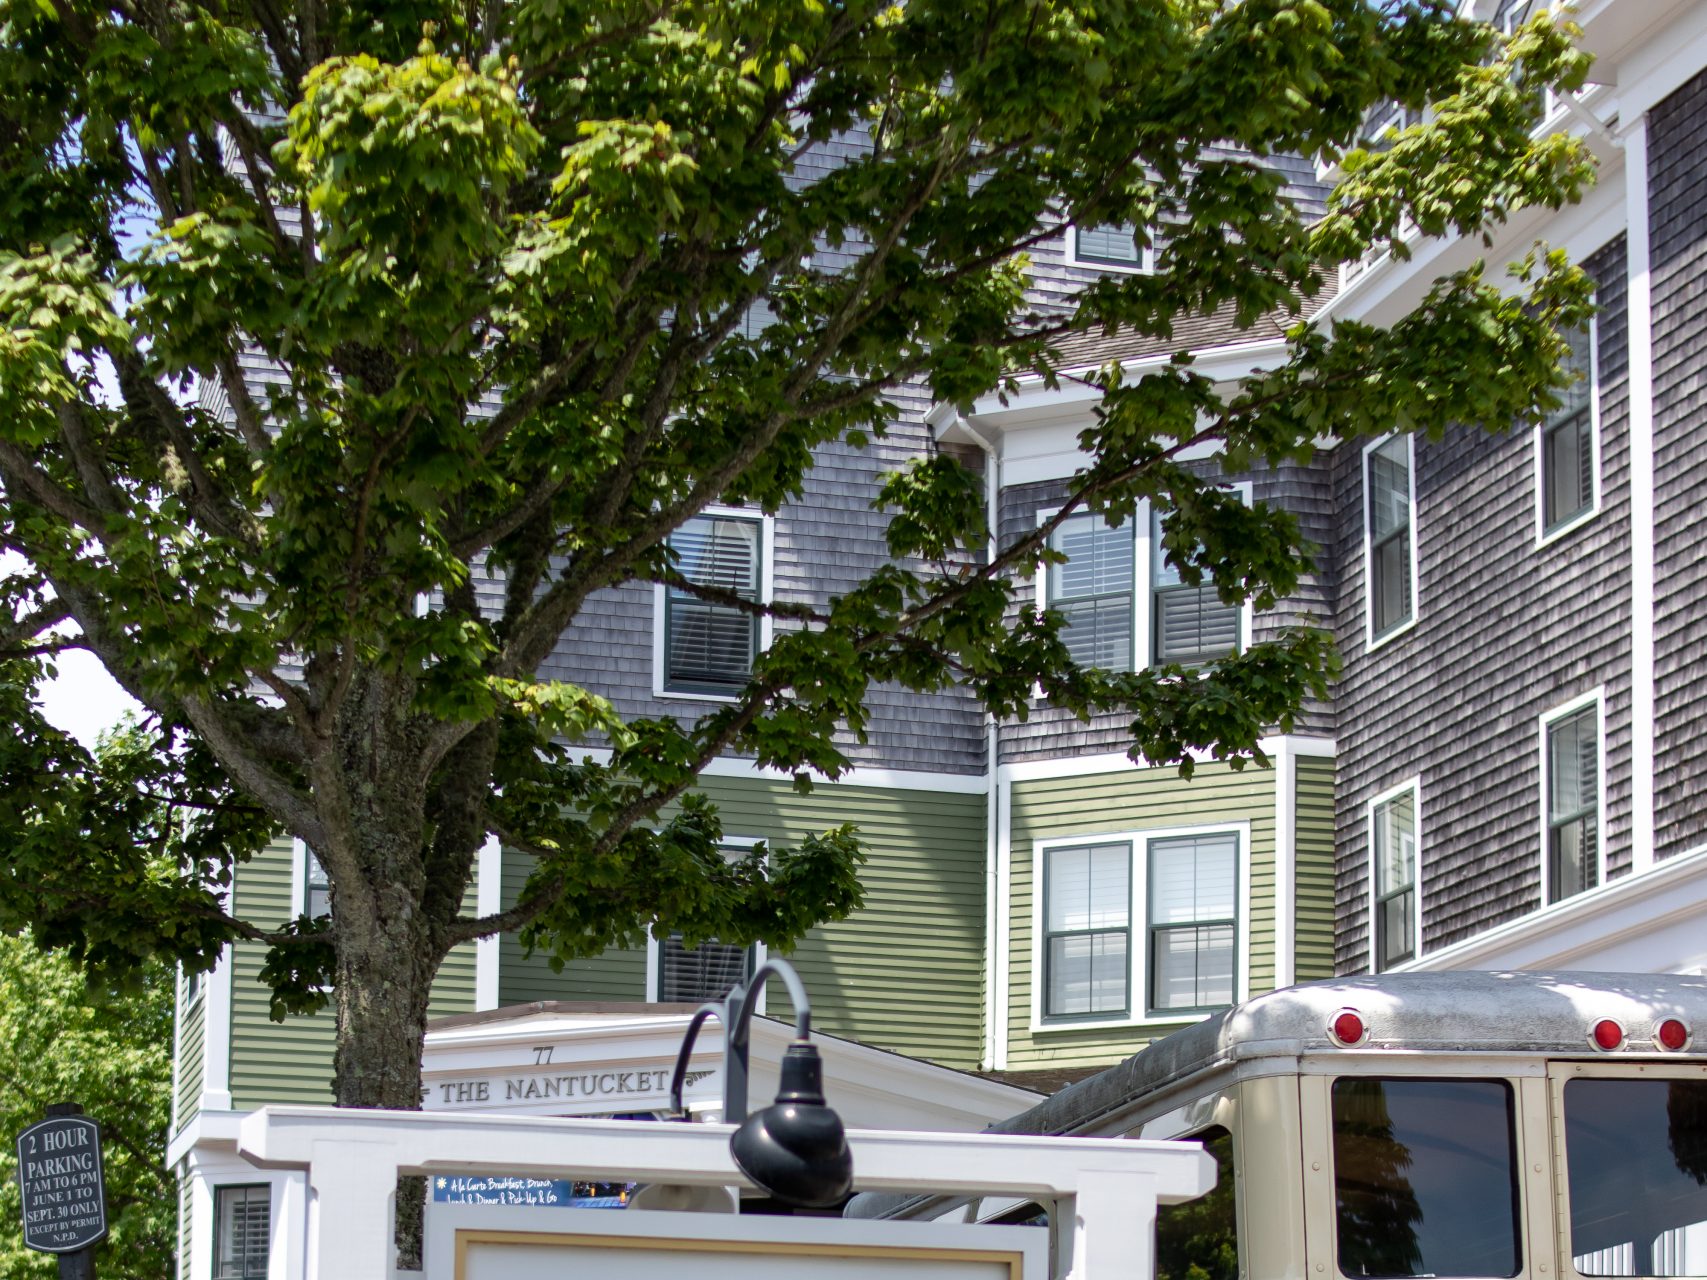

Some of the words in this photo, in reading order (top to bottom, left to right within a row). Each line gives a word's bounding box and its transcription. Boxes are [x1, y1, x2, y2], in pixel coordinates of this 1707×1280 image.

[533, 1046, 554, 1065] 77
[440, 1081, 490, 1103] THE
[506, 1070, 669, 1100] NANTUCKET
[29, 1136, 37, 1154] 2
[44, 1127, 89, 1152] HOUR
[28, 1153, 93, 1179] PARKING
[26, 1182, 31, 1194] 7
[34, 1179, 51, 1192] AM
[53, 1176, 69, 1189] TO
[72, 1175, 78, 1186] 6
[80, 1171, 97, 1185] PM
[33, 1192, 64, 1206] JUNE
[68, 1191, 72, 1201] 1
[75, 1187, 93, 1199] TO
[476, 1193, 499, 1205] Dinner
[500, 1192, 506, 1205] &
[539, 1190, 545, 1204] &
[547, 1190, 557, 1203] Go
[28, 1208, 55, 1223] SEPT.
[58, 1206, 68, 1218] 30
[70, 1200, 100, 1216] ONLY
[30, 1223, 58, 1235] EXCEPT
[60, 1222, 70, 1231] BY
[72, 1216, 101, 1228] PERMIT
[53, 1232, 79, 1242] N.P.D.
